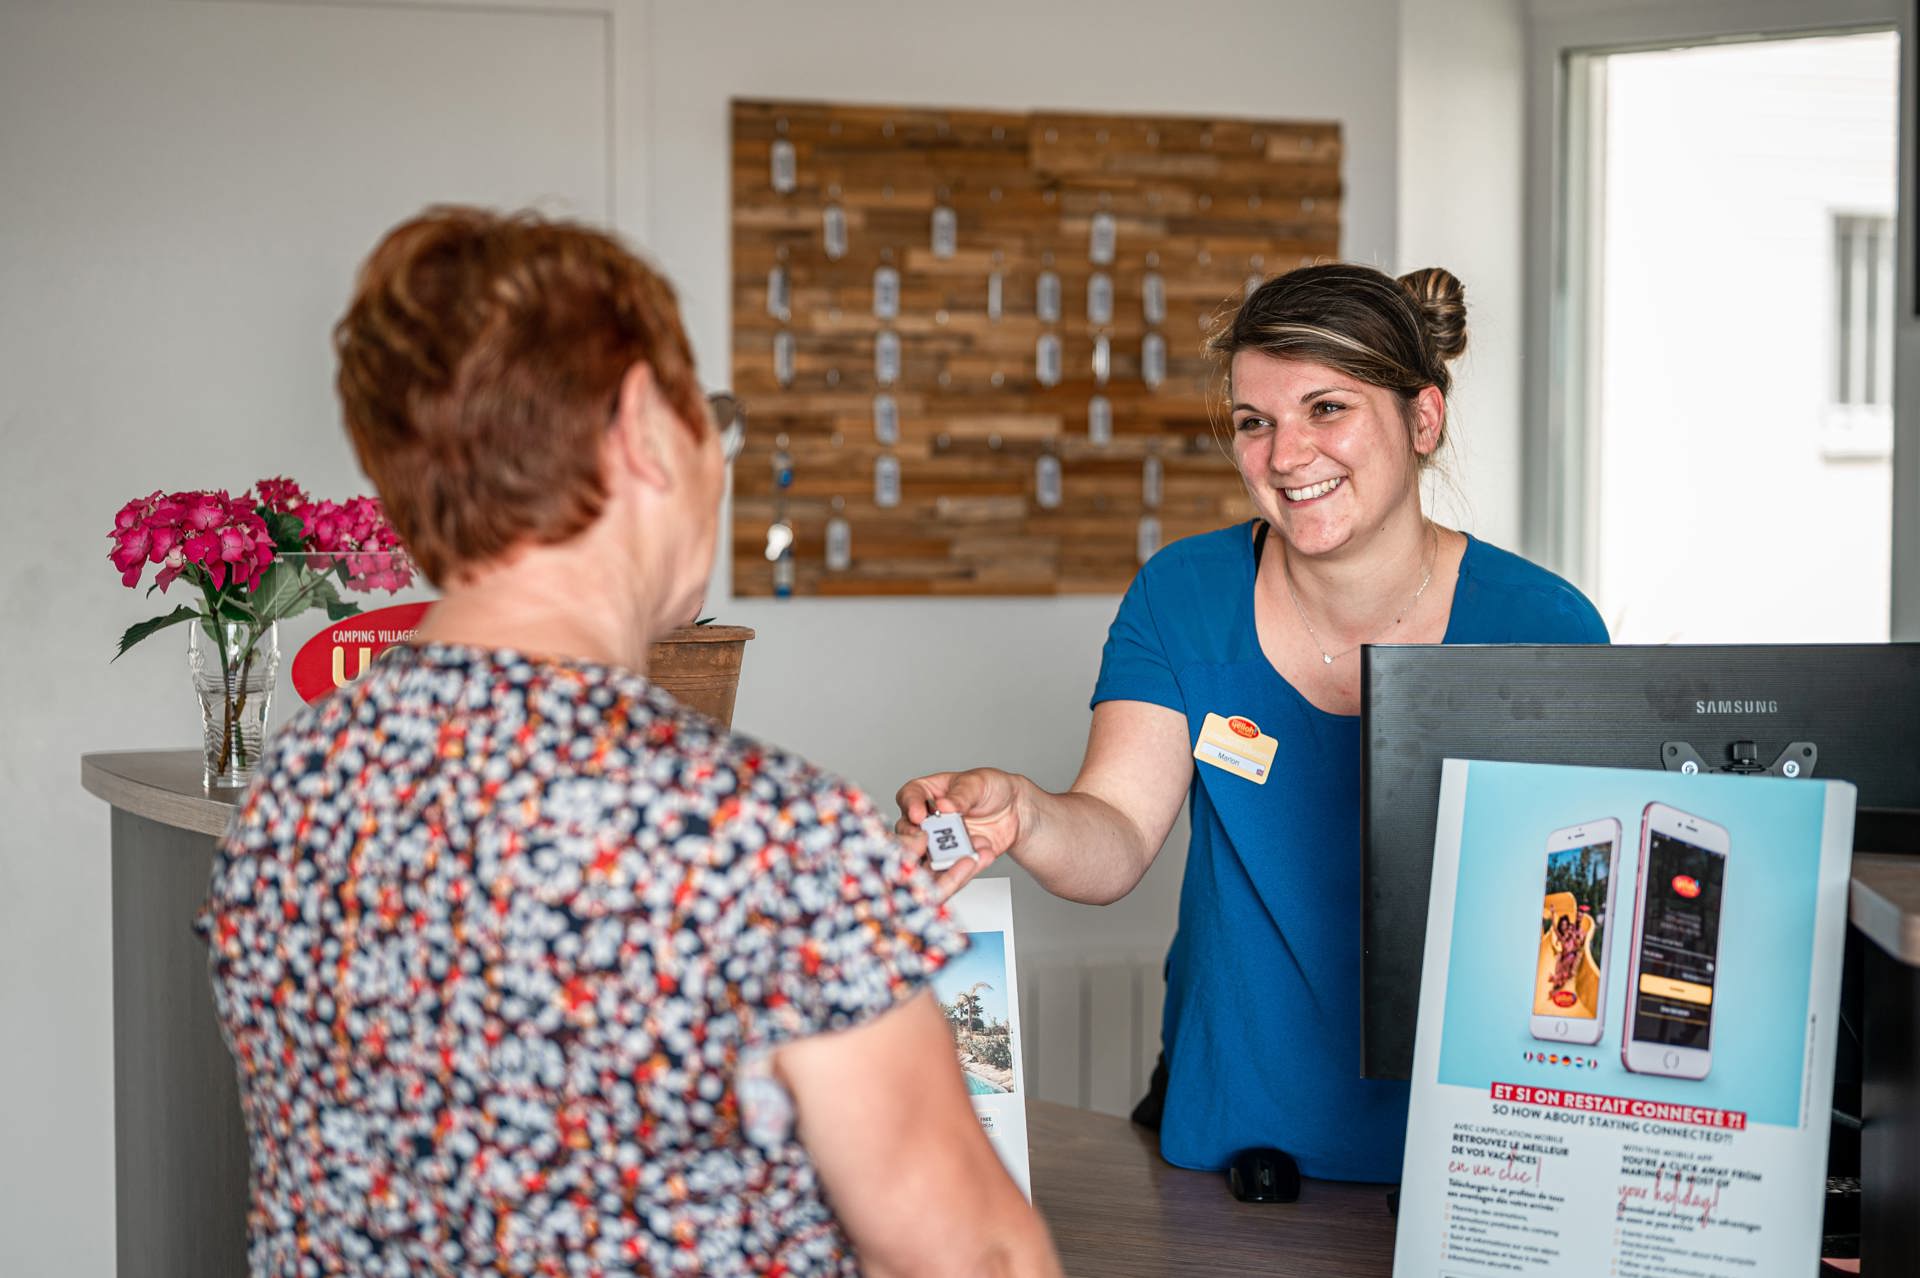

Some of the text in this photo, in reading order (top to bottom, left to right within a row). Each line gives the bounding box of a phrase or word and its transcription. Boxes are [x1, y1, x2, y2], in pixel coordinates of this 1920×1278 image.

[332, 630, 375, 643] CAMPING
[1696, 700, 1778, 714] SAMSUNG
[1218, 752, 1240, 767] Marion
[1494, 1085, 1513, 1100] ET
[1515, 1087, 1531, 1102] SI
[1534, 1089, 1560, 1105] ON
[1563, 1092, 1628, 1114] RESTAIT
[1728, 1113, 1743, 1129] ?!
[1492, 1104, 1508, 1116] SO
[1511, 1106, 1541, 1119] HOW
[1544, 1111, 1585, 1125] ABOUT
[1588, 1116, 1639, 1132] STAYING
[1454, 1123, 1473, 1132] AVEC
[1534, 1132, 1564, 1143] MOBILE
[1452, 1133, 1569, 1156] RETROUVEZ LE MEILLEUR
[1451, 1145, 1537, 1165] DE VOS VACANCES
[1663, 1149, 1694, 1160] MOBILE
[1448, 1160, 1469, 1174] en
[1472, 1163, 1495, 1177] un
[1621, 1167, 1662, 1180] MAKING
[1686, 1174, 1714, 1185] MOST
[1622, 1155, 1657, 1168] YOU'RE
[1668, 1161, 1698, 1172] CLICK
[1701, 1165, 1729, 1177] AWAY
[1731, 1169, 1763, 1182] FROM
